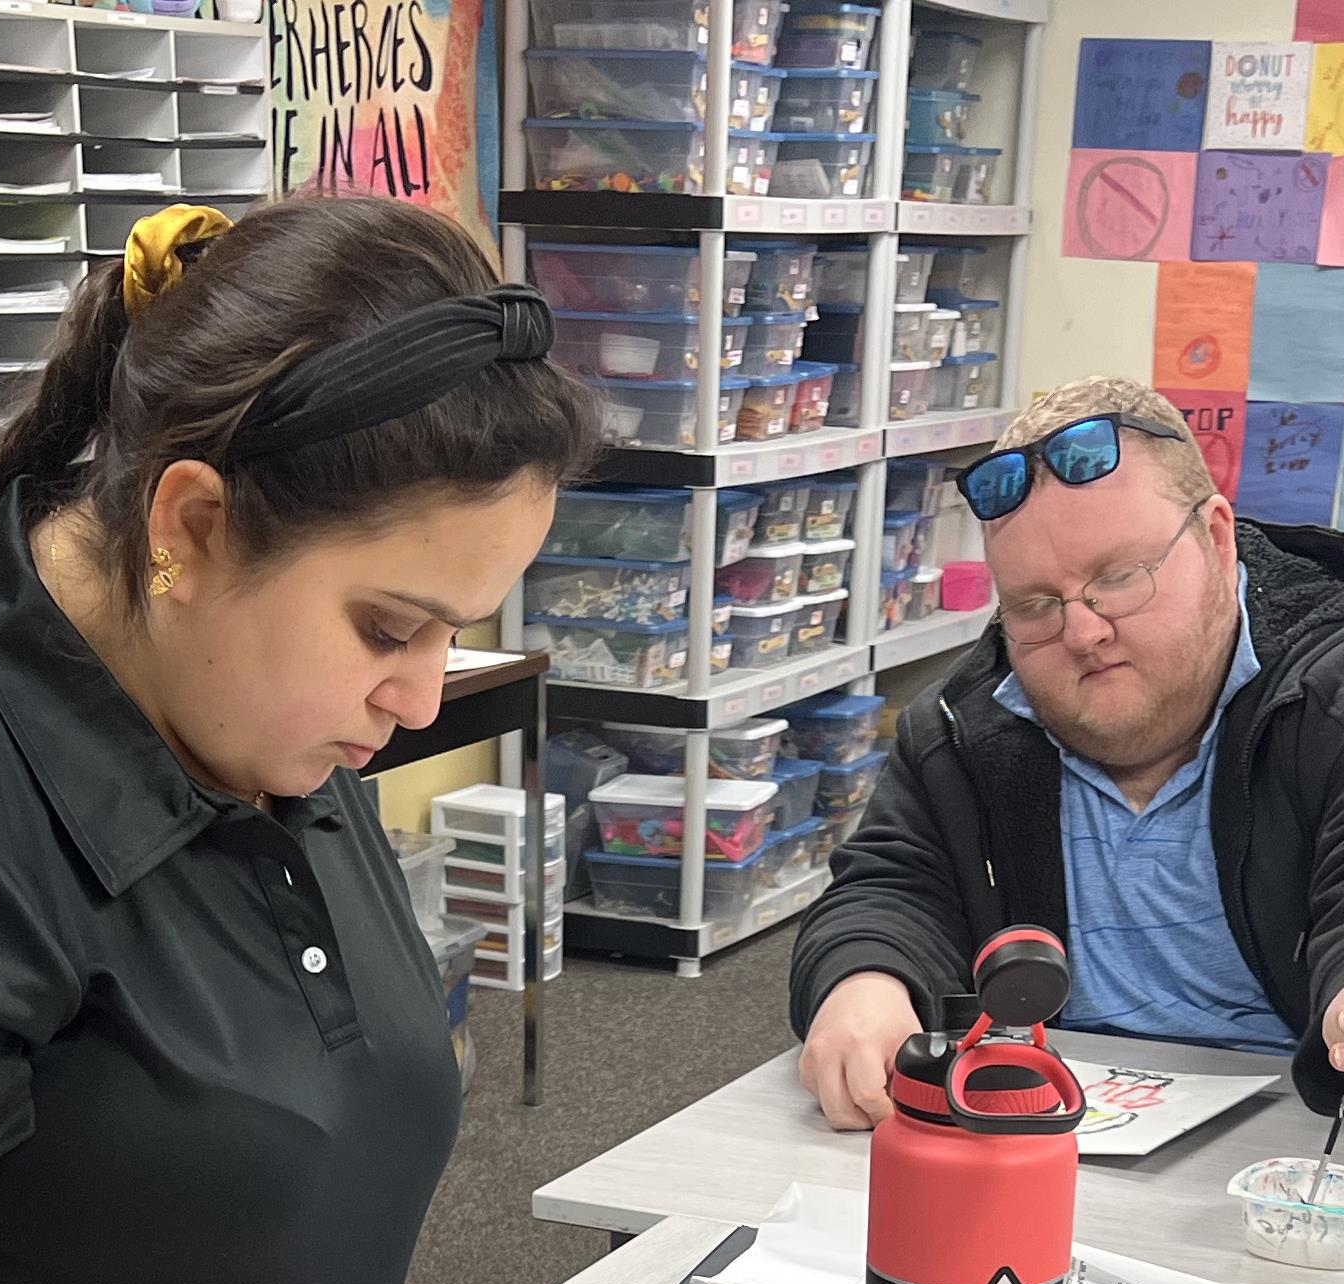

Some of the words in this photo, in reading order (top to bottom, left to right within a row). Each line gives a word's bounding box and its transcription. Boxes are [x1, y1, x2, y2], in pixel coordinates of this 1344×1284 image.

[267, 0, 433, 106] ERHEROES
[1225, 53, 1296, 77] DONUT
[1224, 95, 1284, 138] happy
[317, 105, 355, 197] IN
[1184, 407, 1233, 432] TOP
